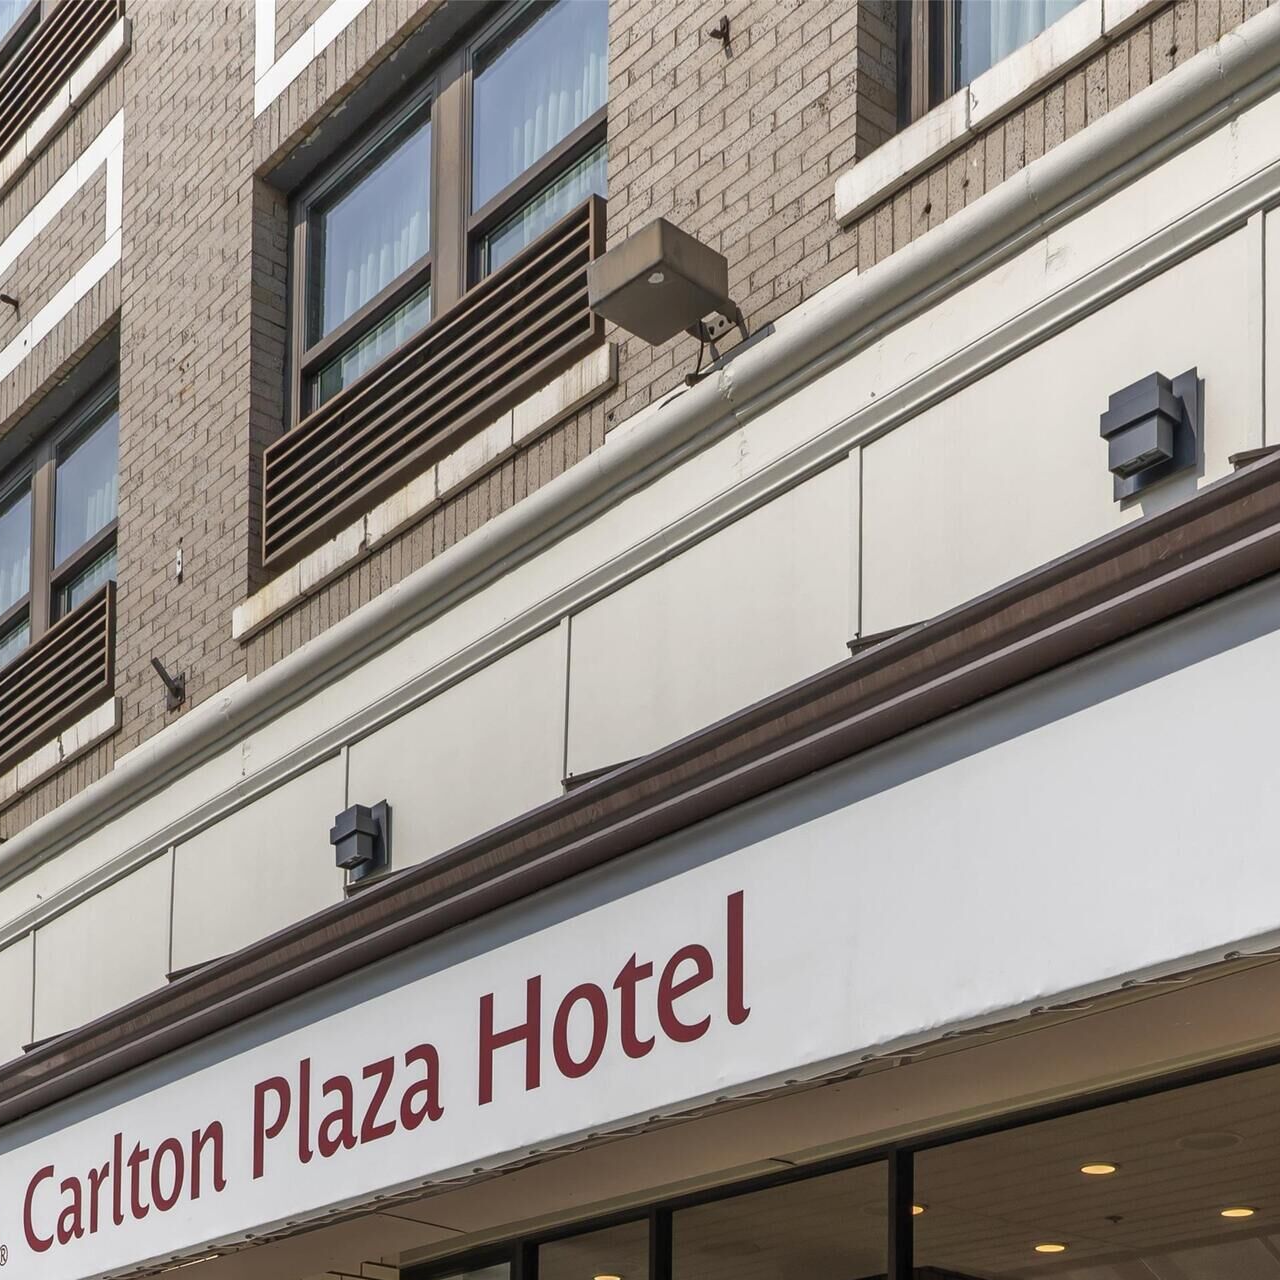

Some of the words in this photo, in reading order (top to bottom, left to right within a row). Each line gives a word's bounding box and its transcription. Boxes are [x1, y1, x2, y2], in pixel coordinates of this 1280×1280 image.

[23, 1120, 227, 1253] Carlton
[253, 1042, 444, 1180] Plaza
[478, 890, 751, 1107] Hotel
